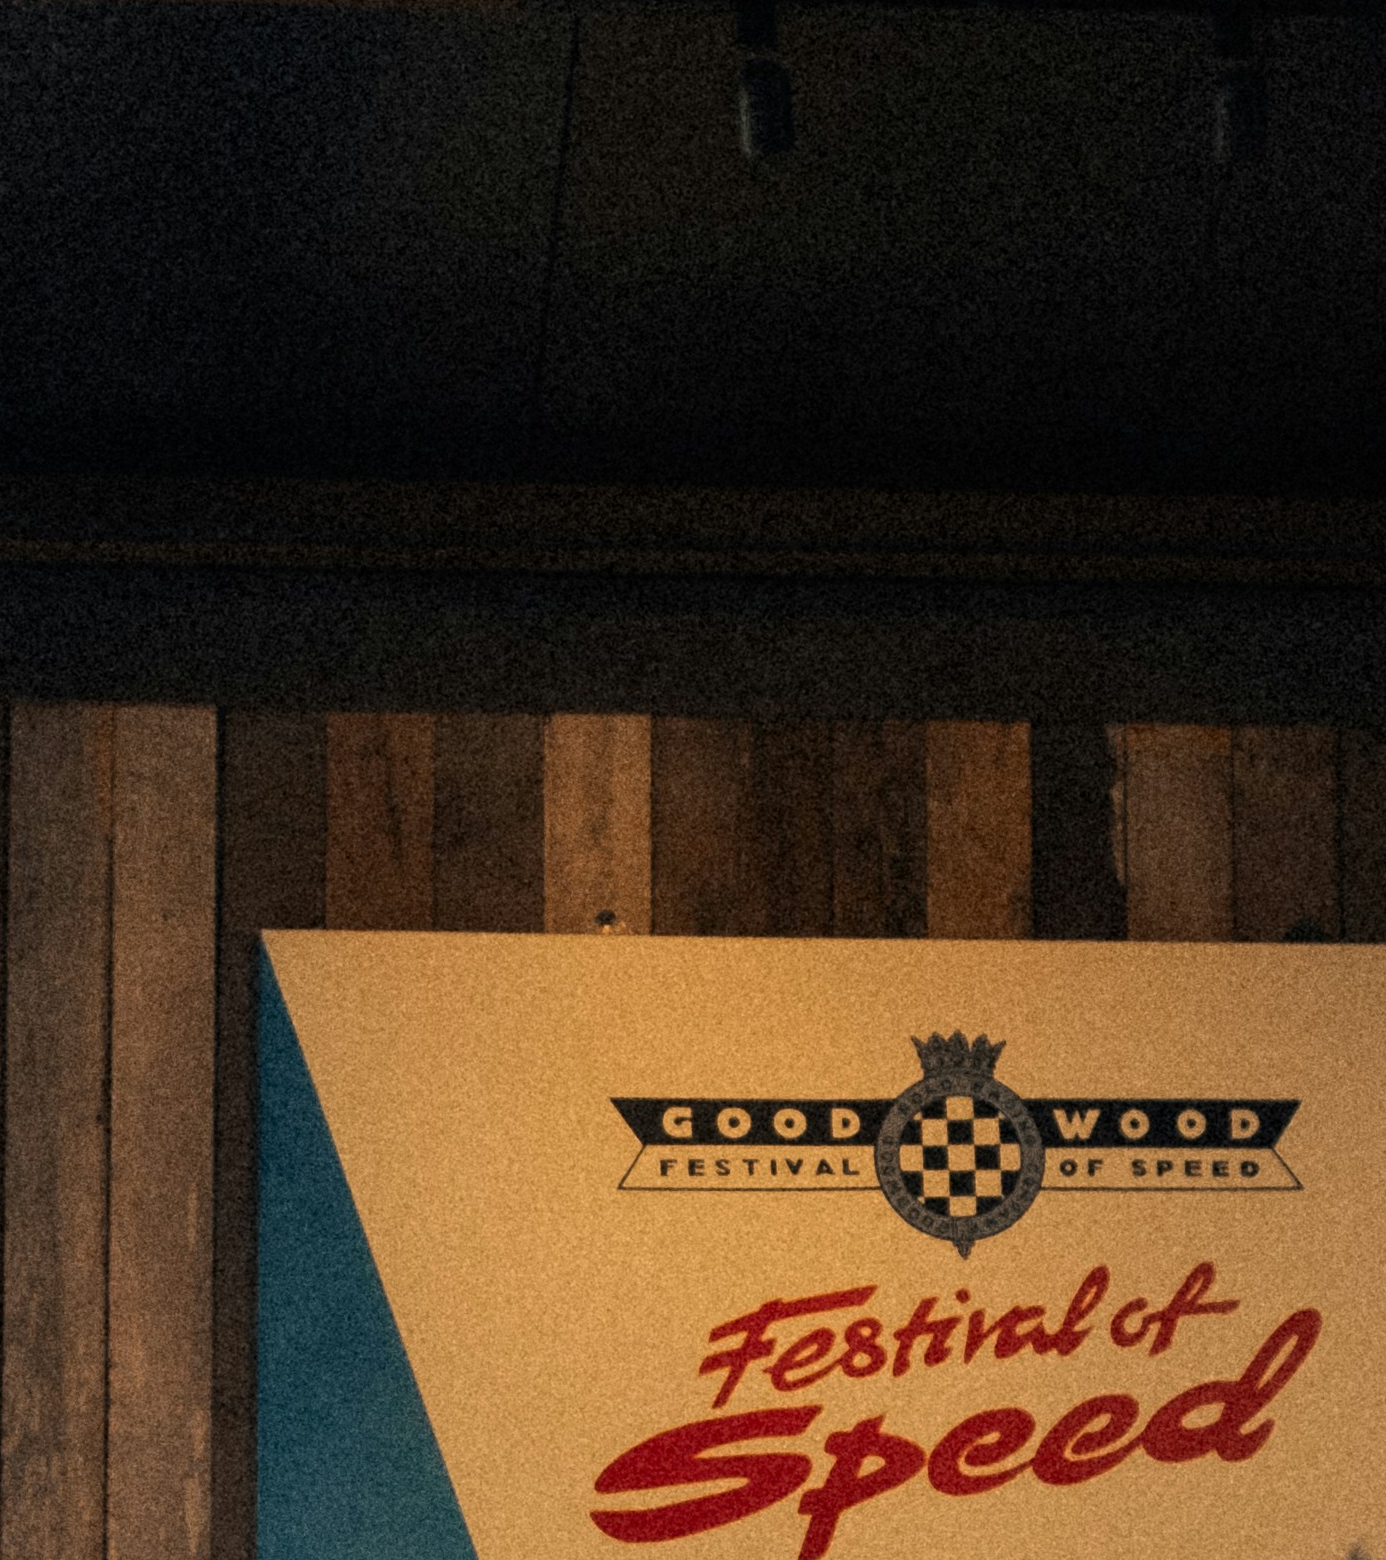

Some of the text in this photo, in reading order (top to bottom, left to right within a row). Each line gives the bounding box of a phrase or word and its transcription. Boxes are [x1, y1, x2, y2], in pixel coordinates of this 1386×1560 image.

[662, 1107, 1262, 1141] GOOD WOOD
[659, 1158, 1261, 1178] FESTIVAL OF SPEED
[699, 1261, 1241, 1408] Festival of
